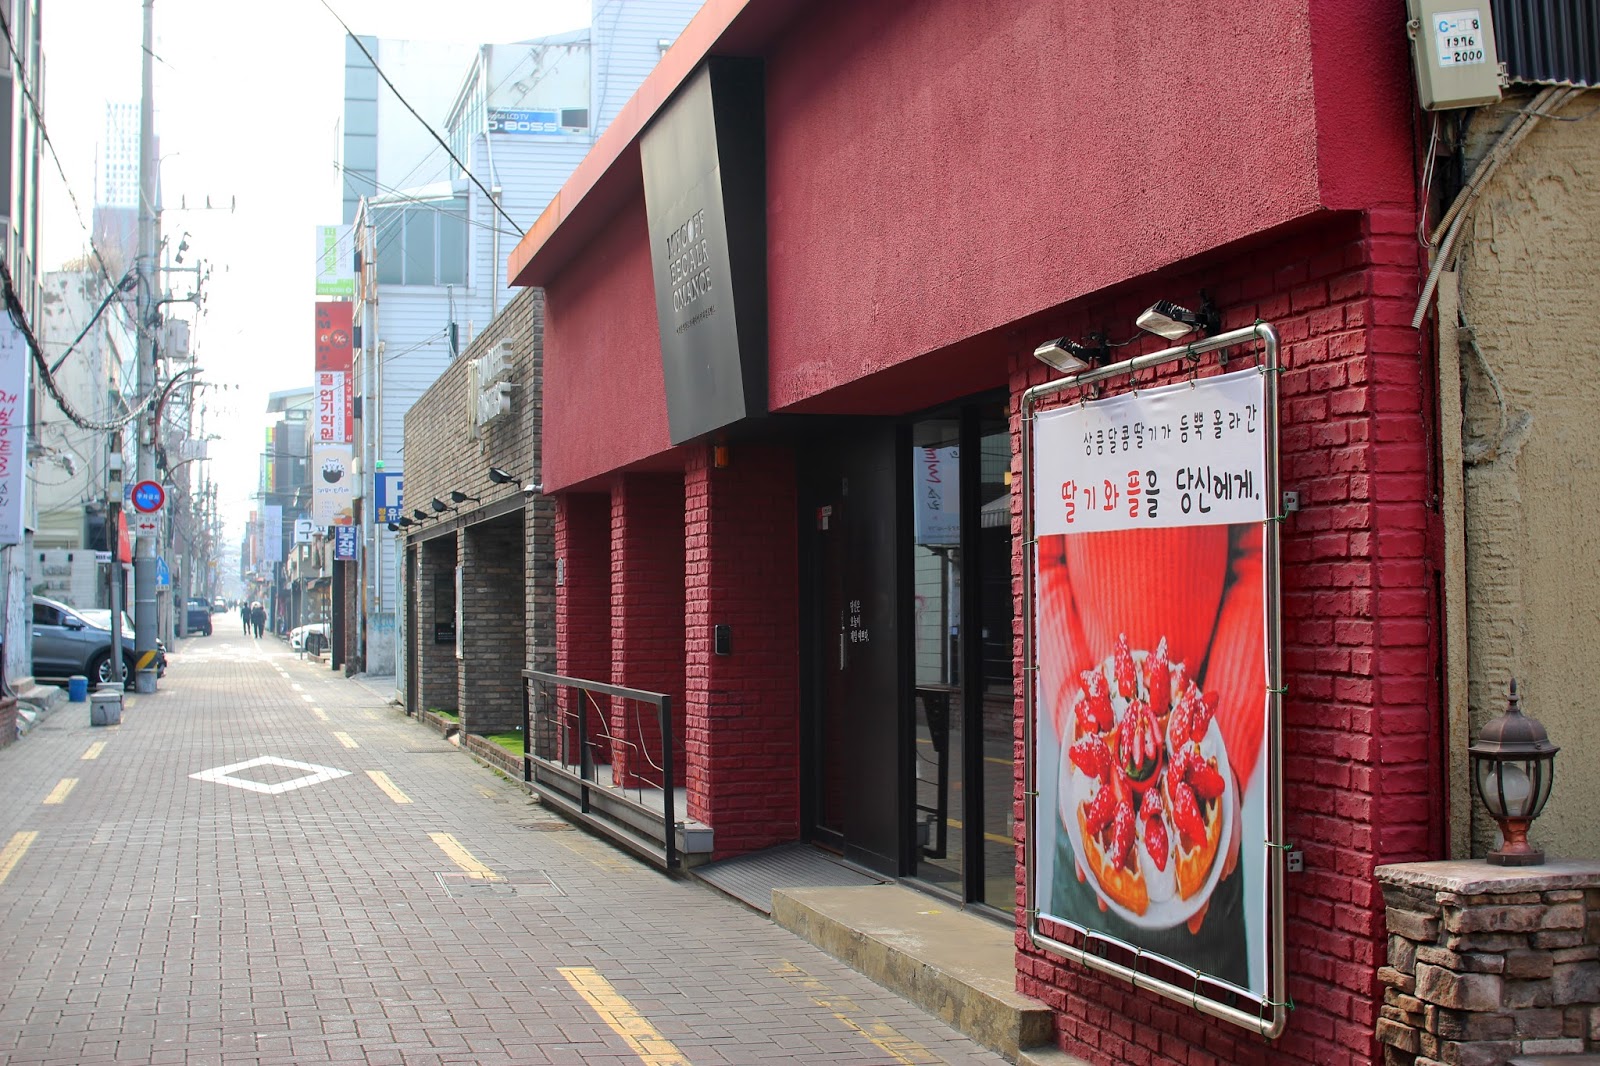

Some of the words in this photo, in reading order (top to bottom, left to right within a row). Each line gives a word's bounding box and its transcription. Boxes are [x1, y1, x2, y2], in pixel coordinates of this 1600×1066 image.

[1179, 411, 1204, 444] 듬뿍
[1212, 403, 1257, 440] 올라간
[1061, 470, 1160, 524] 딸기와플을
[1176, 465, 1260, 514] 당신에게.
